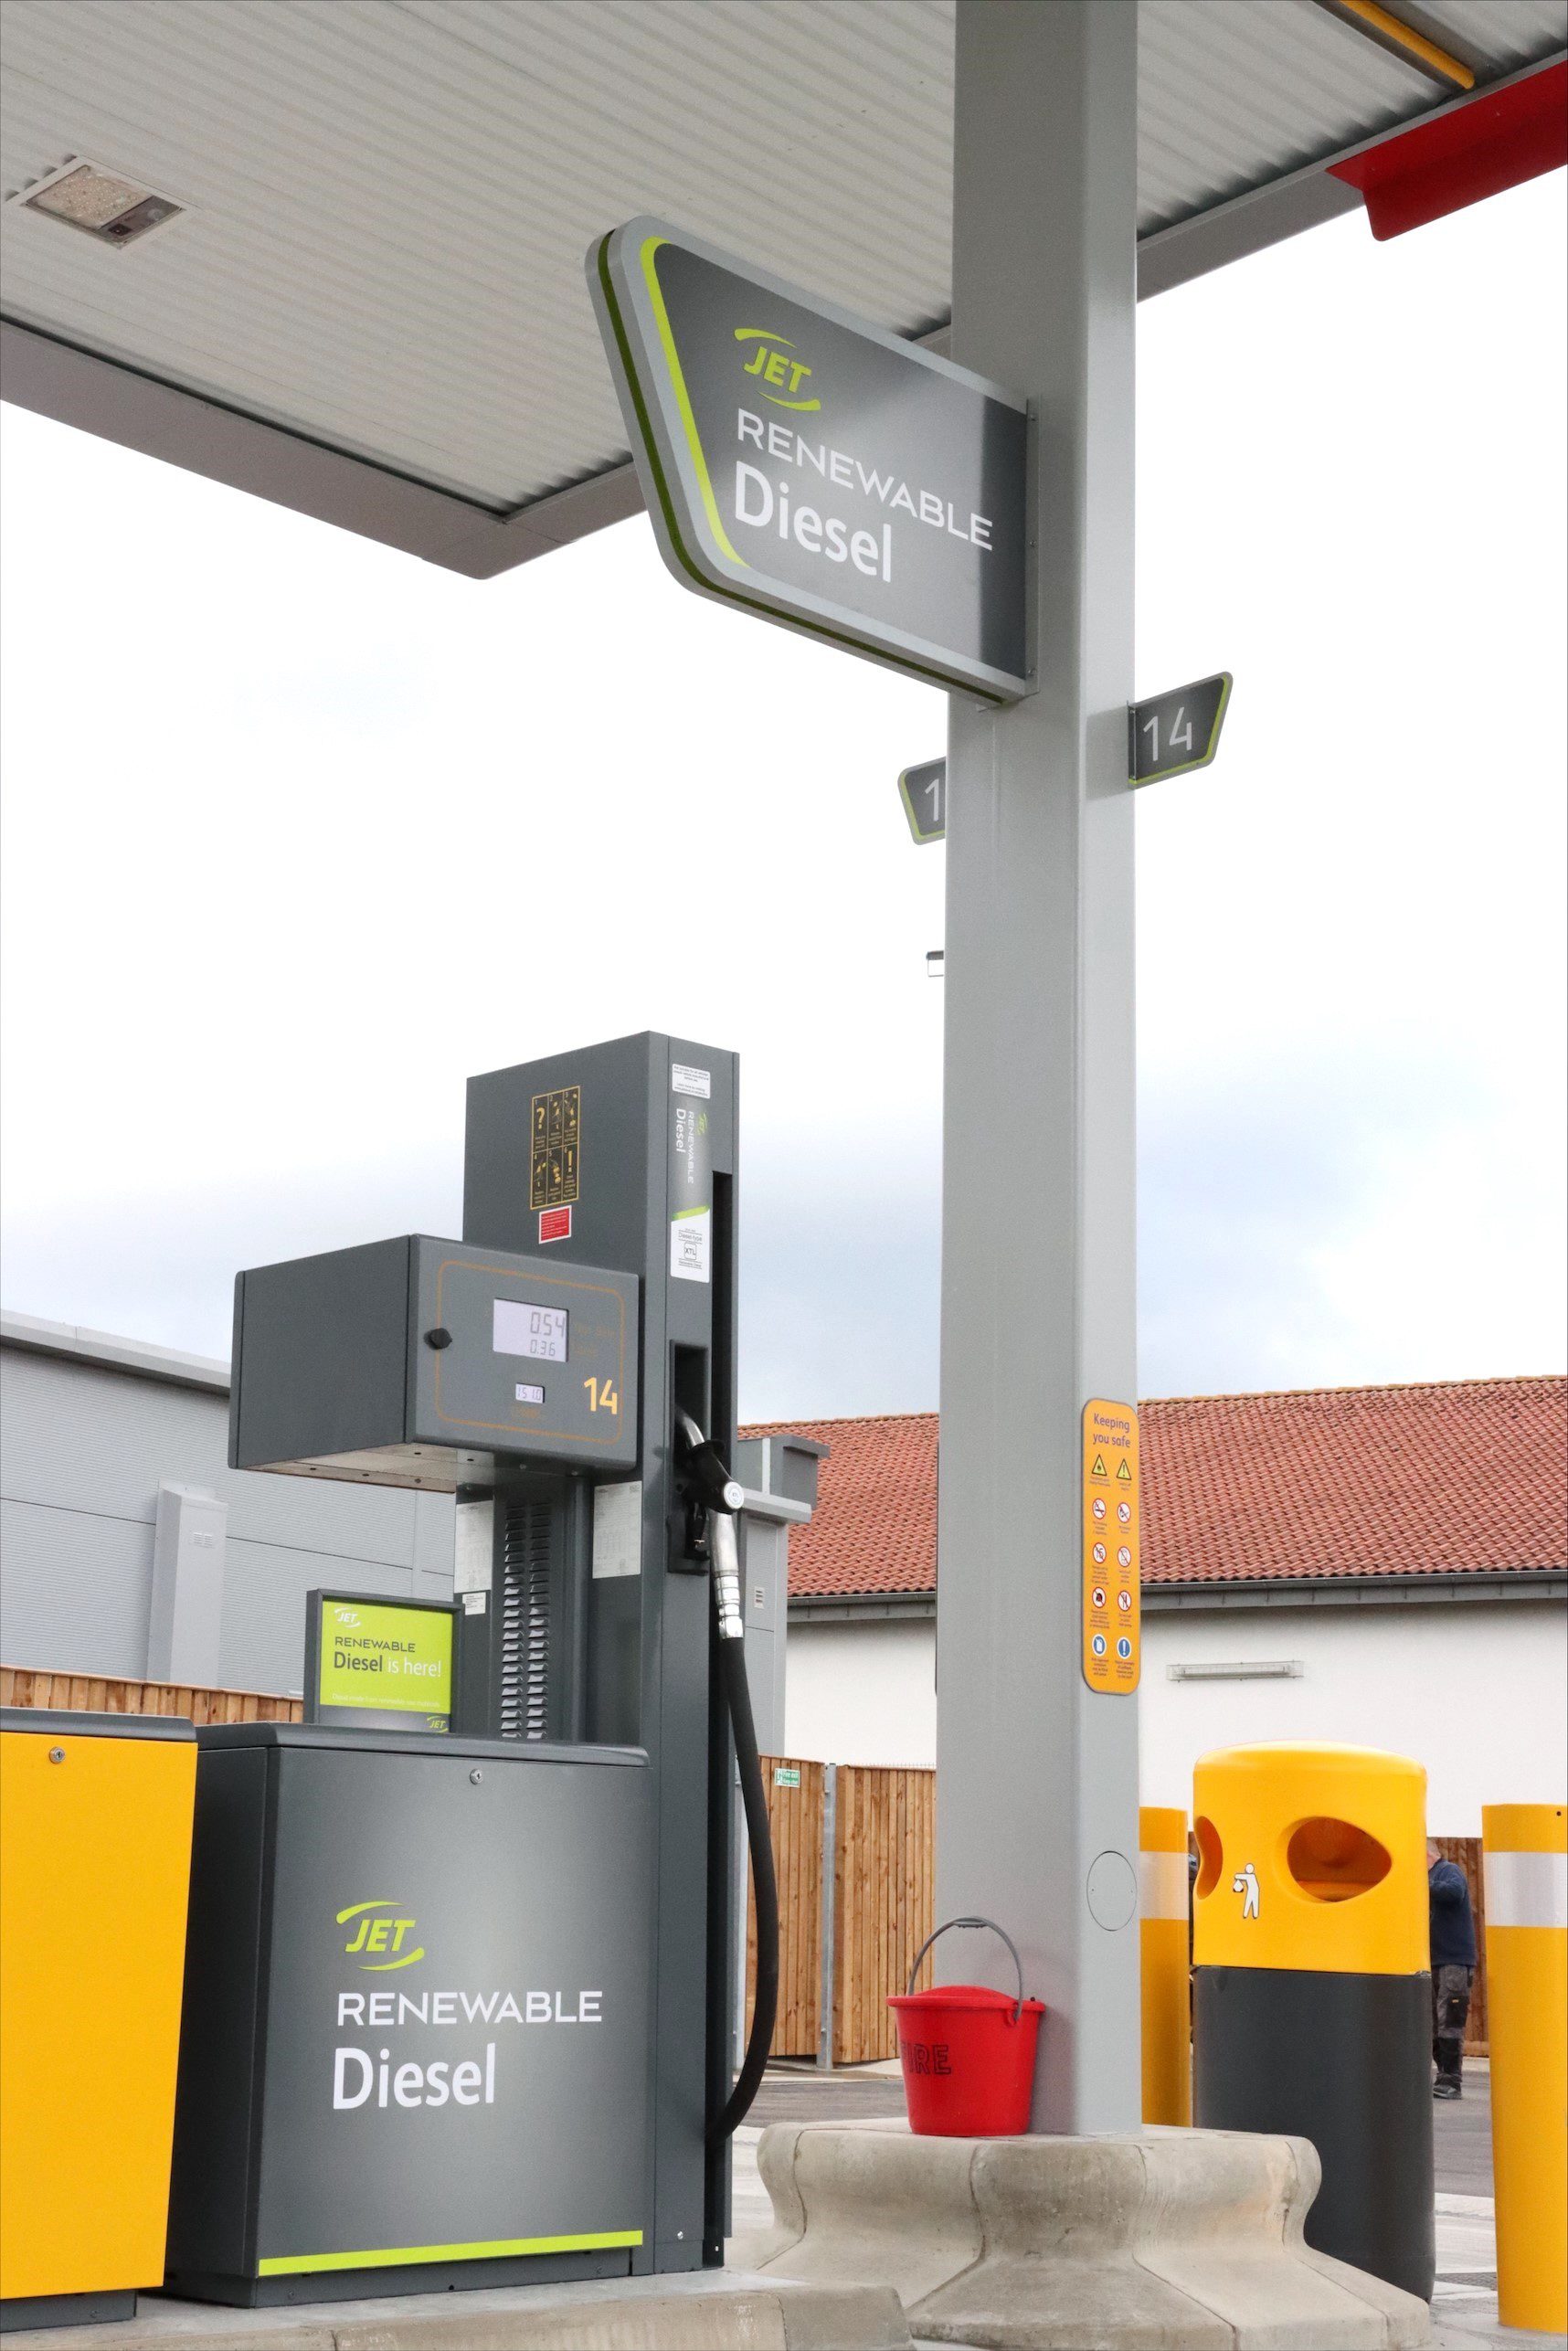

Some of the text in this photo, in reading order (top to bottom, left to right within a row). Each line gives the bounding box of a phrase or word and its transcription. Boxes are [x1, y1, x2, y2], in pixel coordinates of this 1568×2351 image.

[743, 346, 812, 393] JET
[737, 408, 993, 551] RENEWABLE
[735, 461, 892, 583] Diesel
[1143, 706, 1192, 761] 14
[676, 1107, 686, 1153] Diesel
[530, 1339, 556, 1357] 0.36
[583, 1376, 618, 1415] 14
[1093, 1433, 1130, 1448] you safe
[1094, 1413, 1130, 1434] Keeping
[334, 1636, 416, 1653] RENEWABLE
[334, 1651, 441, 1678] Diesel is here!
[344, 1919, 416, 1953] JET
[337, 1990, 603, 2027] RENEWABLE
[333, 2042, 496, 2110] Diesel
